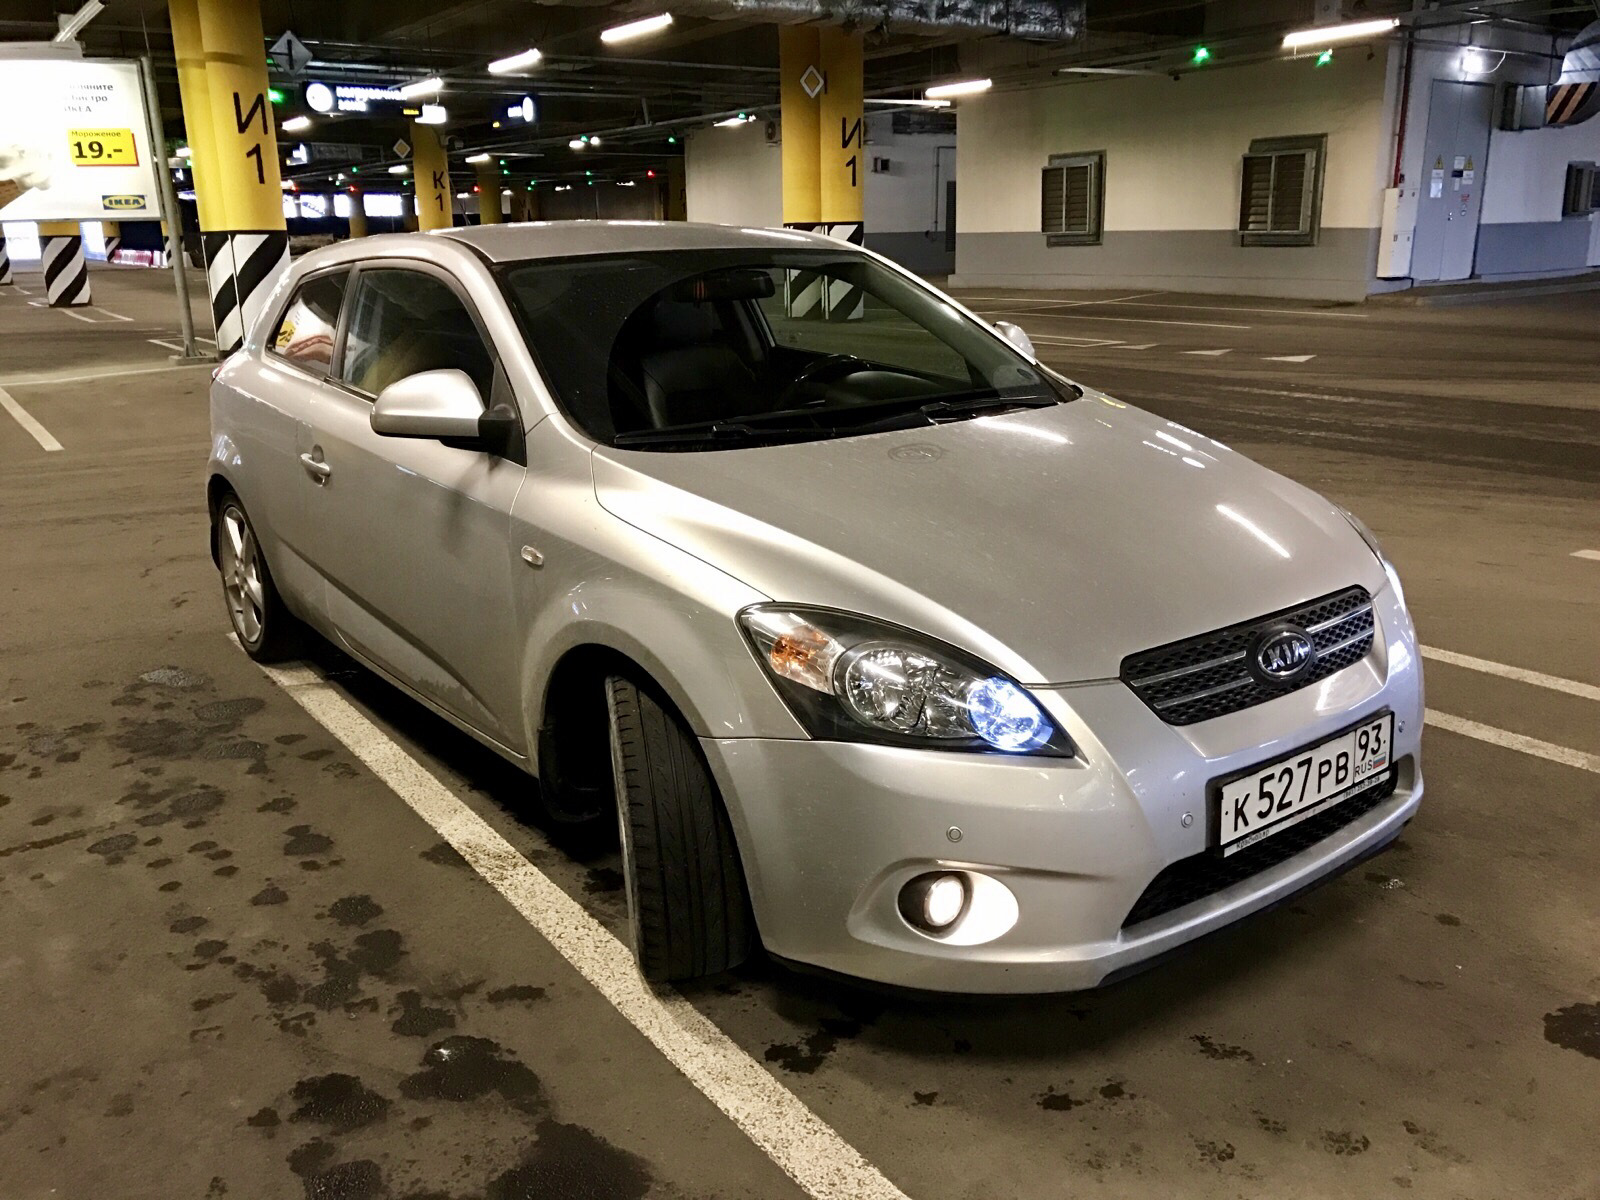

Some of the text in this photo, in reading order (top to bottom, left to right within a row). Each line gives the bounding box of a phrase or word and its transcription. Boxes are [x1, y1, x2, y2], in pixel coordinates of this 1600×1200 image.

[233, 92, 268, 135] И
[71, 130, 122, 138] Мороженое
[841, 117, 862, 149] И
[246, 143, 265, 184] 1
[845, 155, 857, 187] 1
[108, 198, 142, 206] IKEA
[435, 193, 444, 211] 1
[1266, 639, 1306, 670] KIA
[1358, 722, 1382, 761] 93
[1354, 759, 1373, 777] RUS
